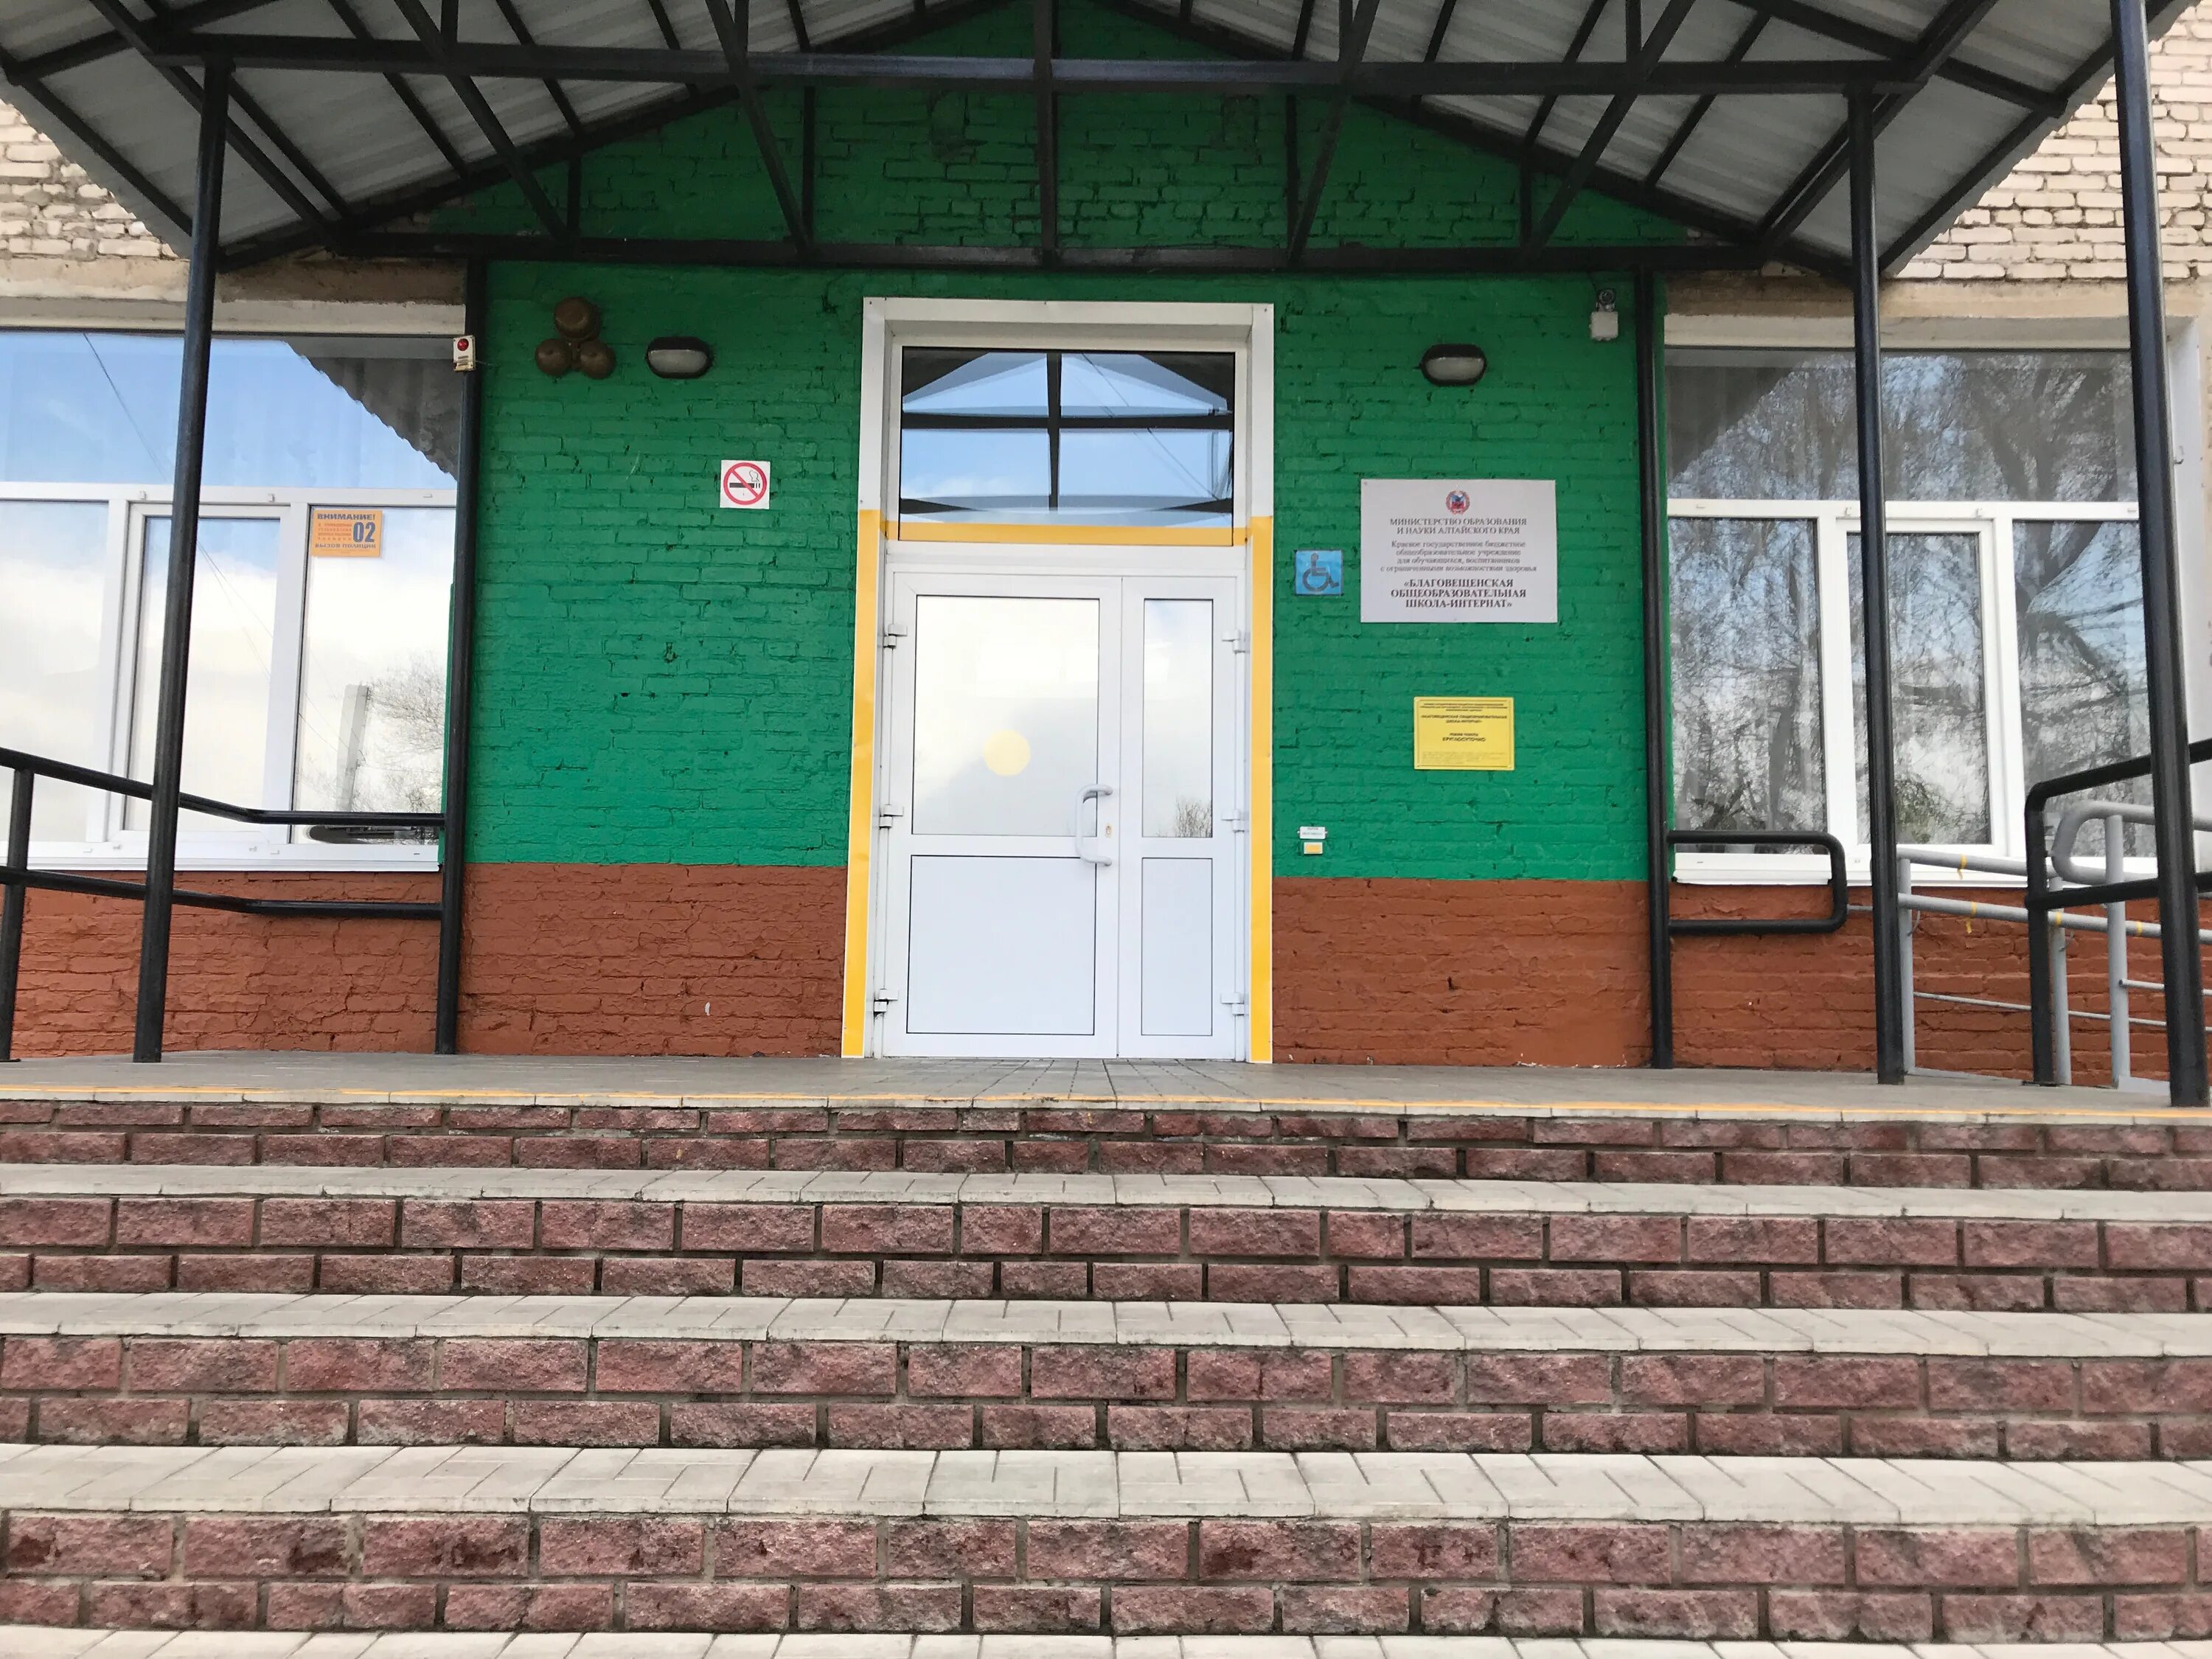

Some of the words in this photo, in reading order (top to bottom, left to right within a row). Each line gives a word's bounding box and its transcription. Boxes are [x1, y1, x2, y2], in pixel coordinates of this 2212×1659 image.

[353, 522, 375, 542] 02
[1438, 526, 1497, 535] АЛТАЙСКОГО
[1404, 579, 1514, 588] «БЛАГОВЕЩЕНСКАЯ
[1391, 589, 1526, 598] ОБЩЕОБРАЗОВАТЕЛЬНАЯ
[1405, 599, 1512, 608] ШКОЛА-ИНТЕРНАТ»
